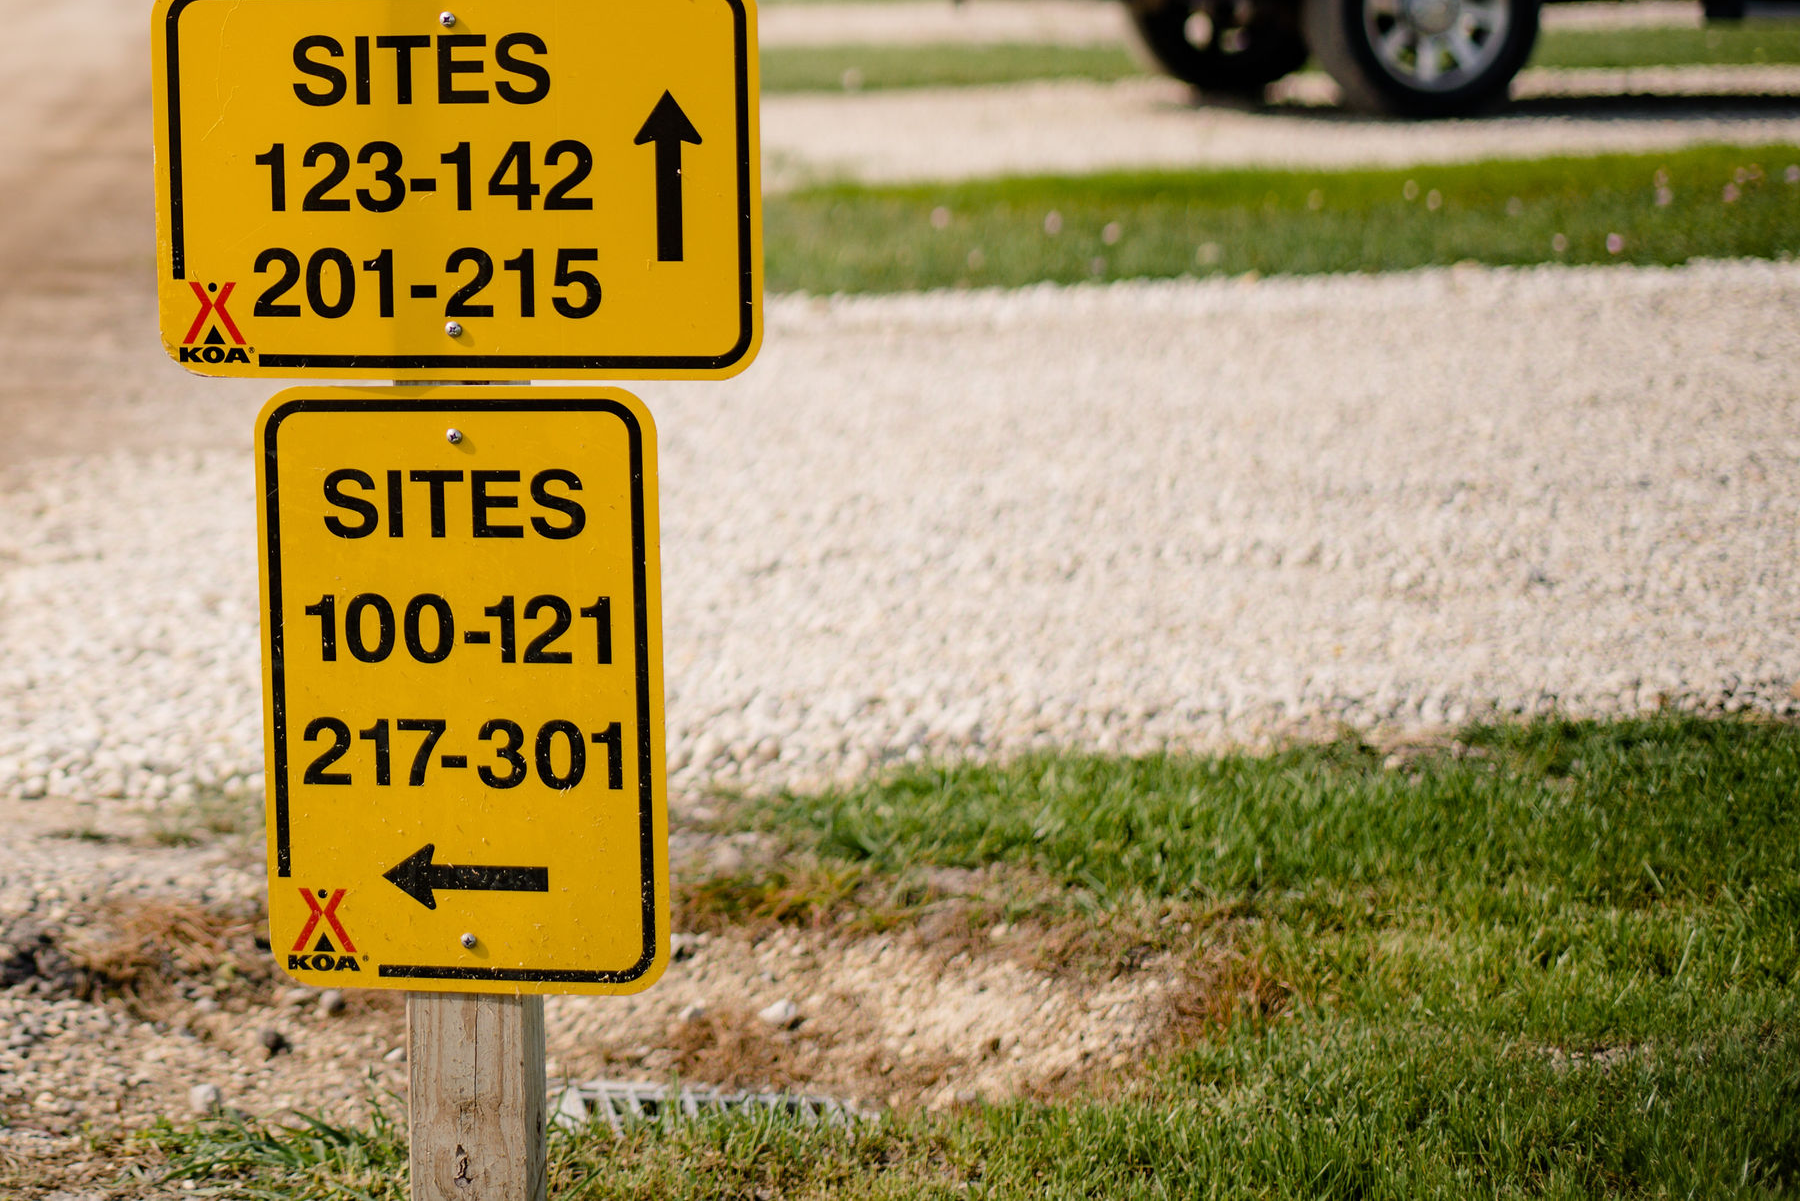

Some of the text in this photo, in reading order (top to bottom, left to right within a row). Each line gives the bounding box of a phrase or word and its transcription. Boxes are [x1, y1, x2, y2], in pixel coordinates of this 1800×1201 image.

[292, 32, 551, 107] SITES
[255, 139, 594, 213] 123-142
[253, 247, 602, 320] 201-215
[179, 346, 251, 364] KOA
[323, 468, 587, 540] SITES
[305, 592, 613, 665] 100-121
[303, 716, 624, 791] 217-301
[287, 954, 361, 972] KOA
